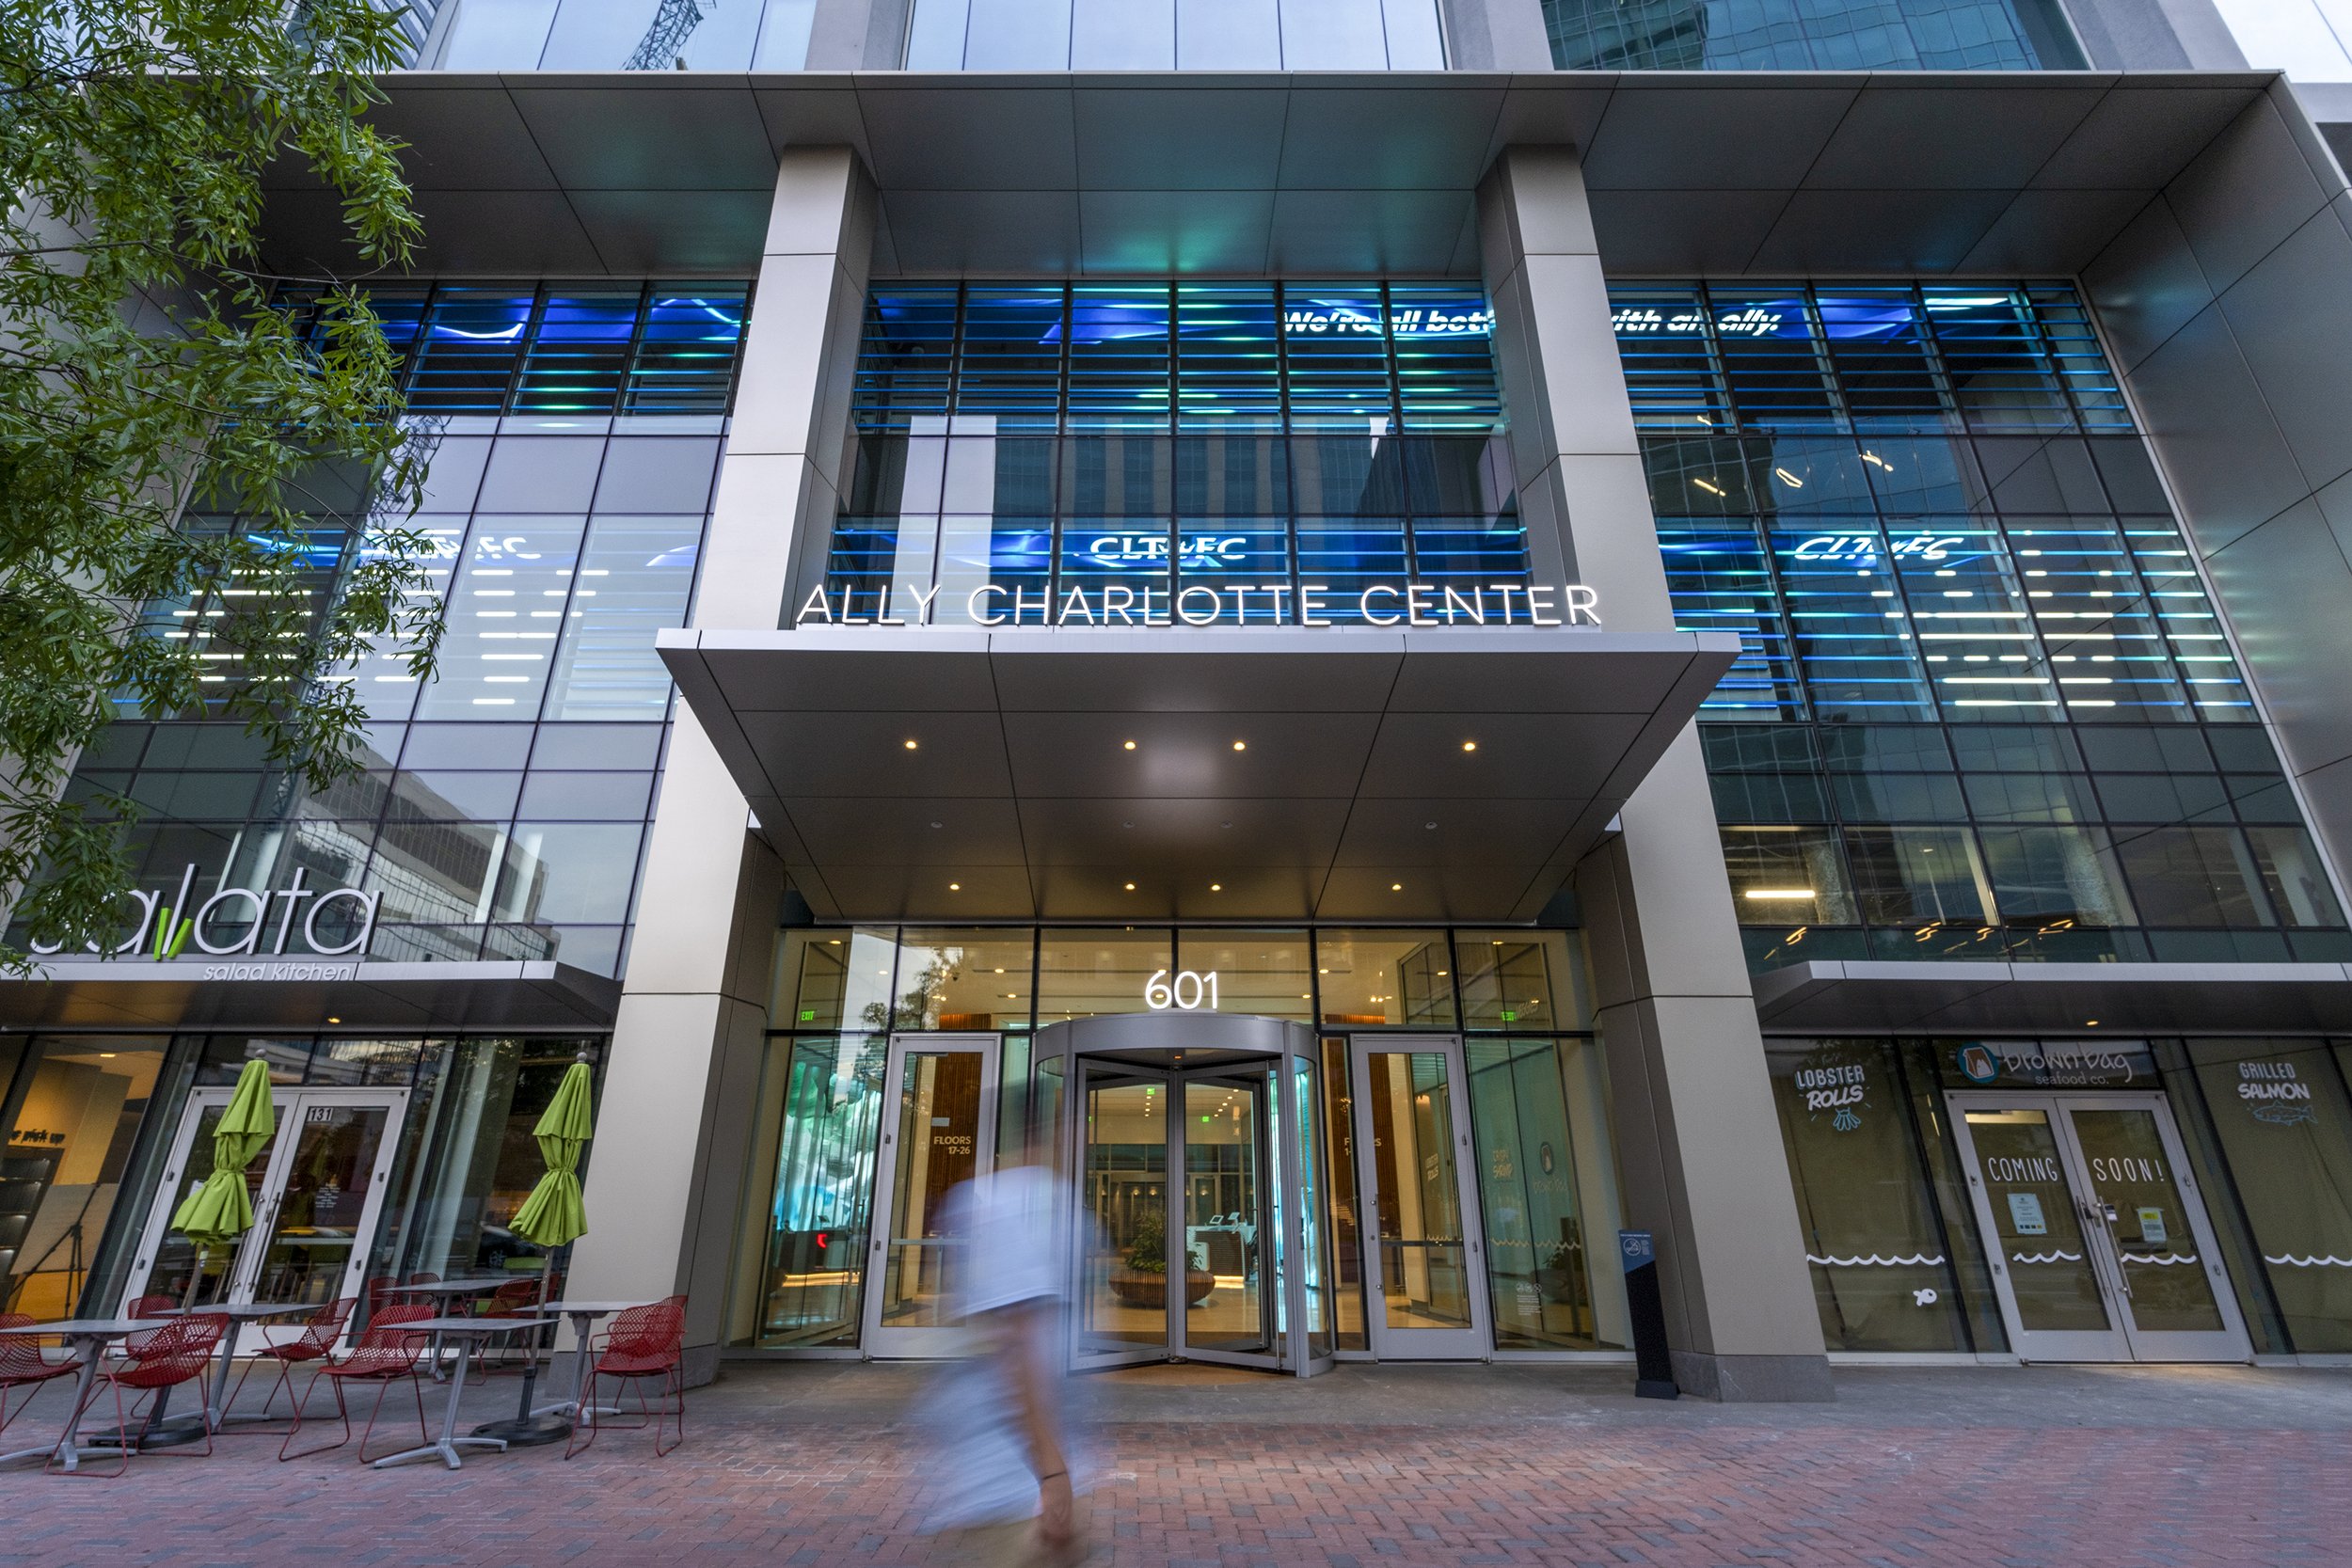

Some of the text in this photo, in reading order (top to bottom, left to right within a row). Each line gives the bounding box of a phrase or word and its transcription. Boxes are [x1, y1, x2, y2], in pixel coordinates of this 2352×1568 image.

[1284, 311, 1372, 332] We're
[1717, 309, 1783, 337] ally.
[796, 583, 1602, 626] ALLY CHARLOTTE CENTER
[202, 962, 352, 981] salad kitchen
[1145, 969, 1218, 1009] 601
[2000, 1044, 2133, 1084] brown bag
[2238, 1062, 2296, 1081] GRILLED
[1795, 1064, 1866, 1089] LOBSTER
[2034, 1069, 2110, 1085] seafood co.
[1805, 1084, 1865, 1112] ROLLS
[2237, 1082, 2312, 1101] SALMON
[310, 1108, 332, 1122] 131
[933, 1135, 972, 1146] FLOORS
[948, 1146, 971, 1155] 17-26
[1987, 1157, 2166, 1182] COMING SOON!
